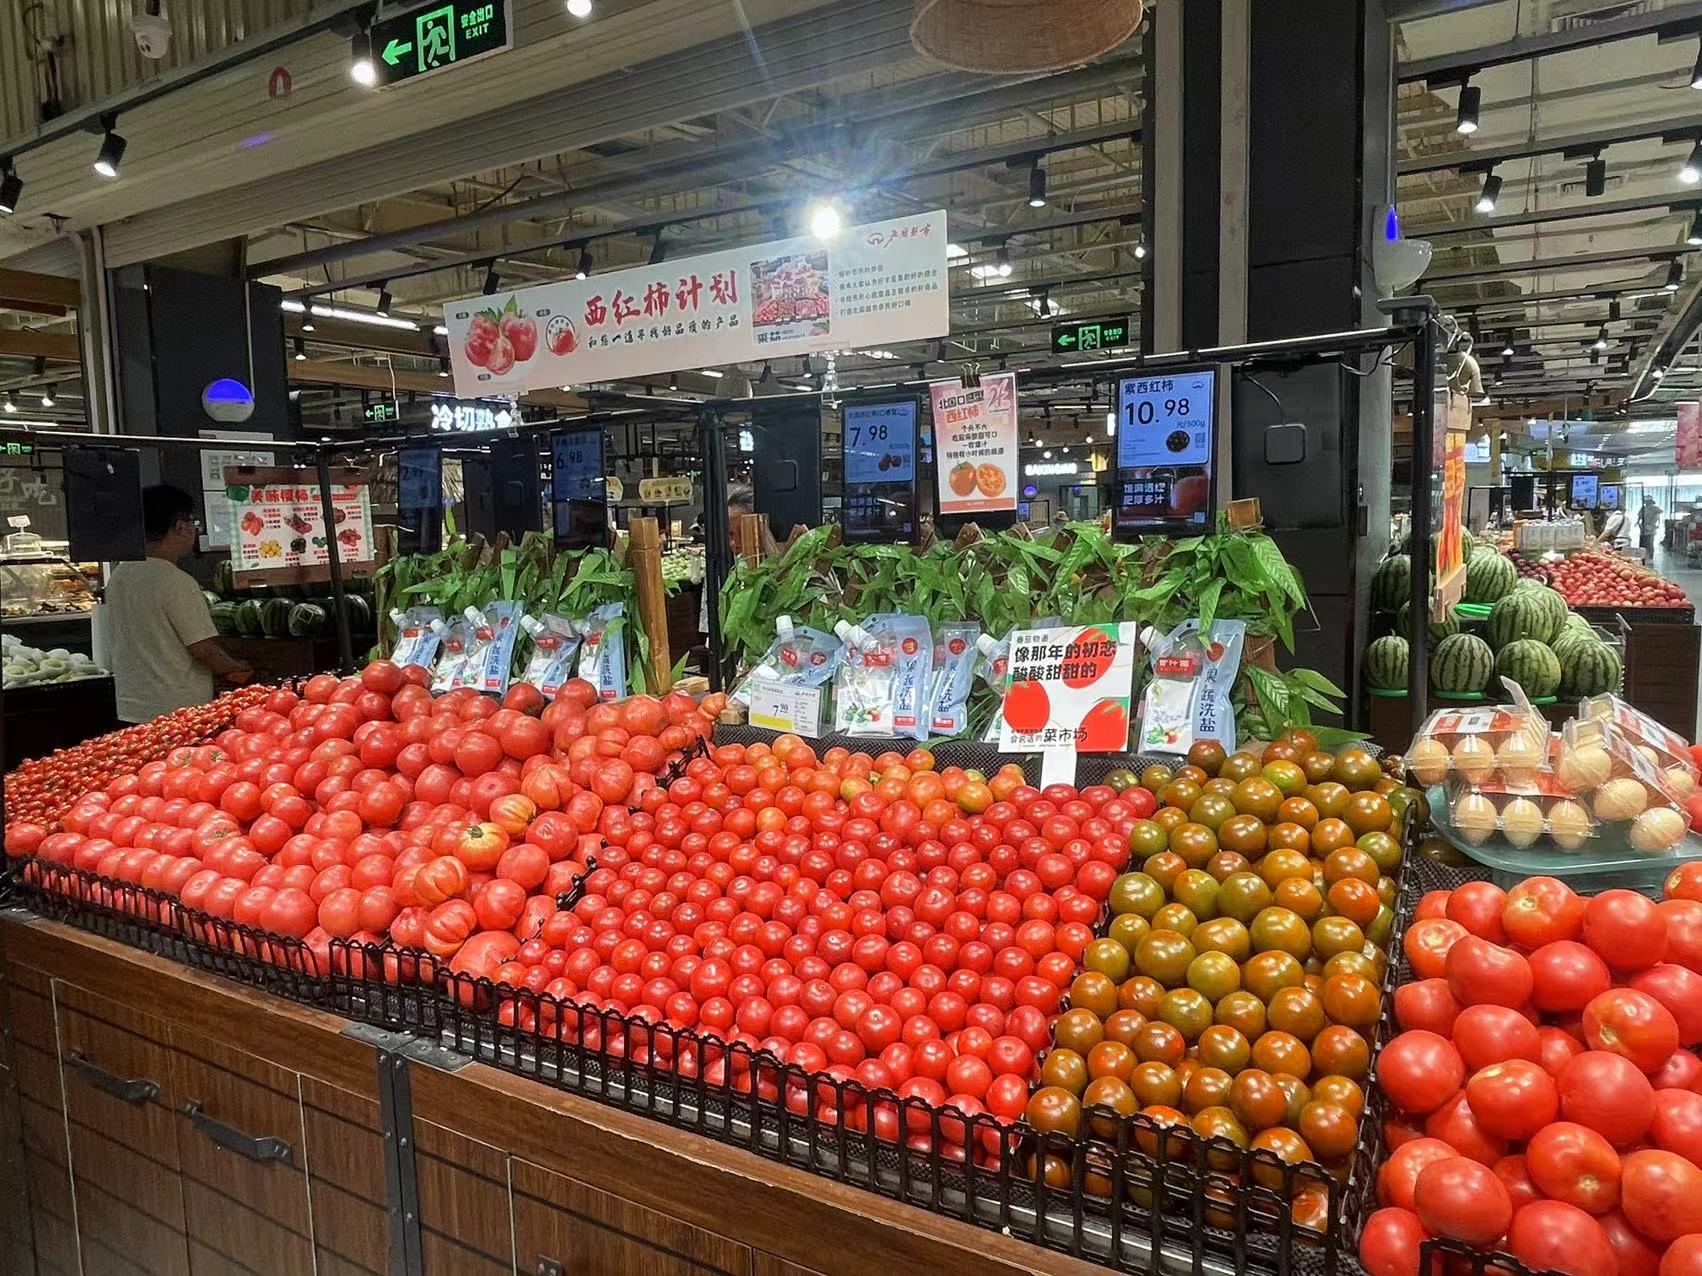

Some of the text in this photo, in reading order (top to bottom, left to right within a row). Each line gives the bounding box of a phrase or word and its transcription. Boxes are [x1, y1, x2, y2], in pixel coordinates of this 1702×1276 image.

[461, 4, 493, 28] 安全出口
[465, 23, 489, 39] EXIT
[584, 270, 738, 327] 西红柿计划
[1124, 380, 1173, 395] 紫西红柿
[946, 405, 980, 423] 西红柿
[1125, 398, 1190, 426] 10.98
[849, 425, 888, 448] 7.98
[1015, 640, 1117, 663] 像那年的初恋
[1012, 662, 1097, 682] 酸酸甜甜的
[1199, 668, 1218, 732] 果蔬洗盐
